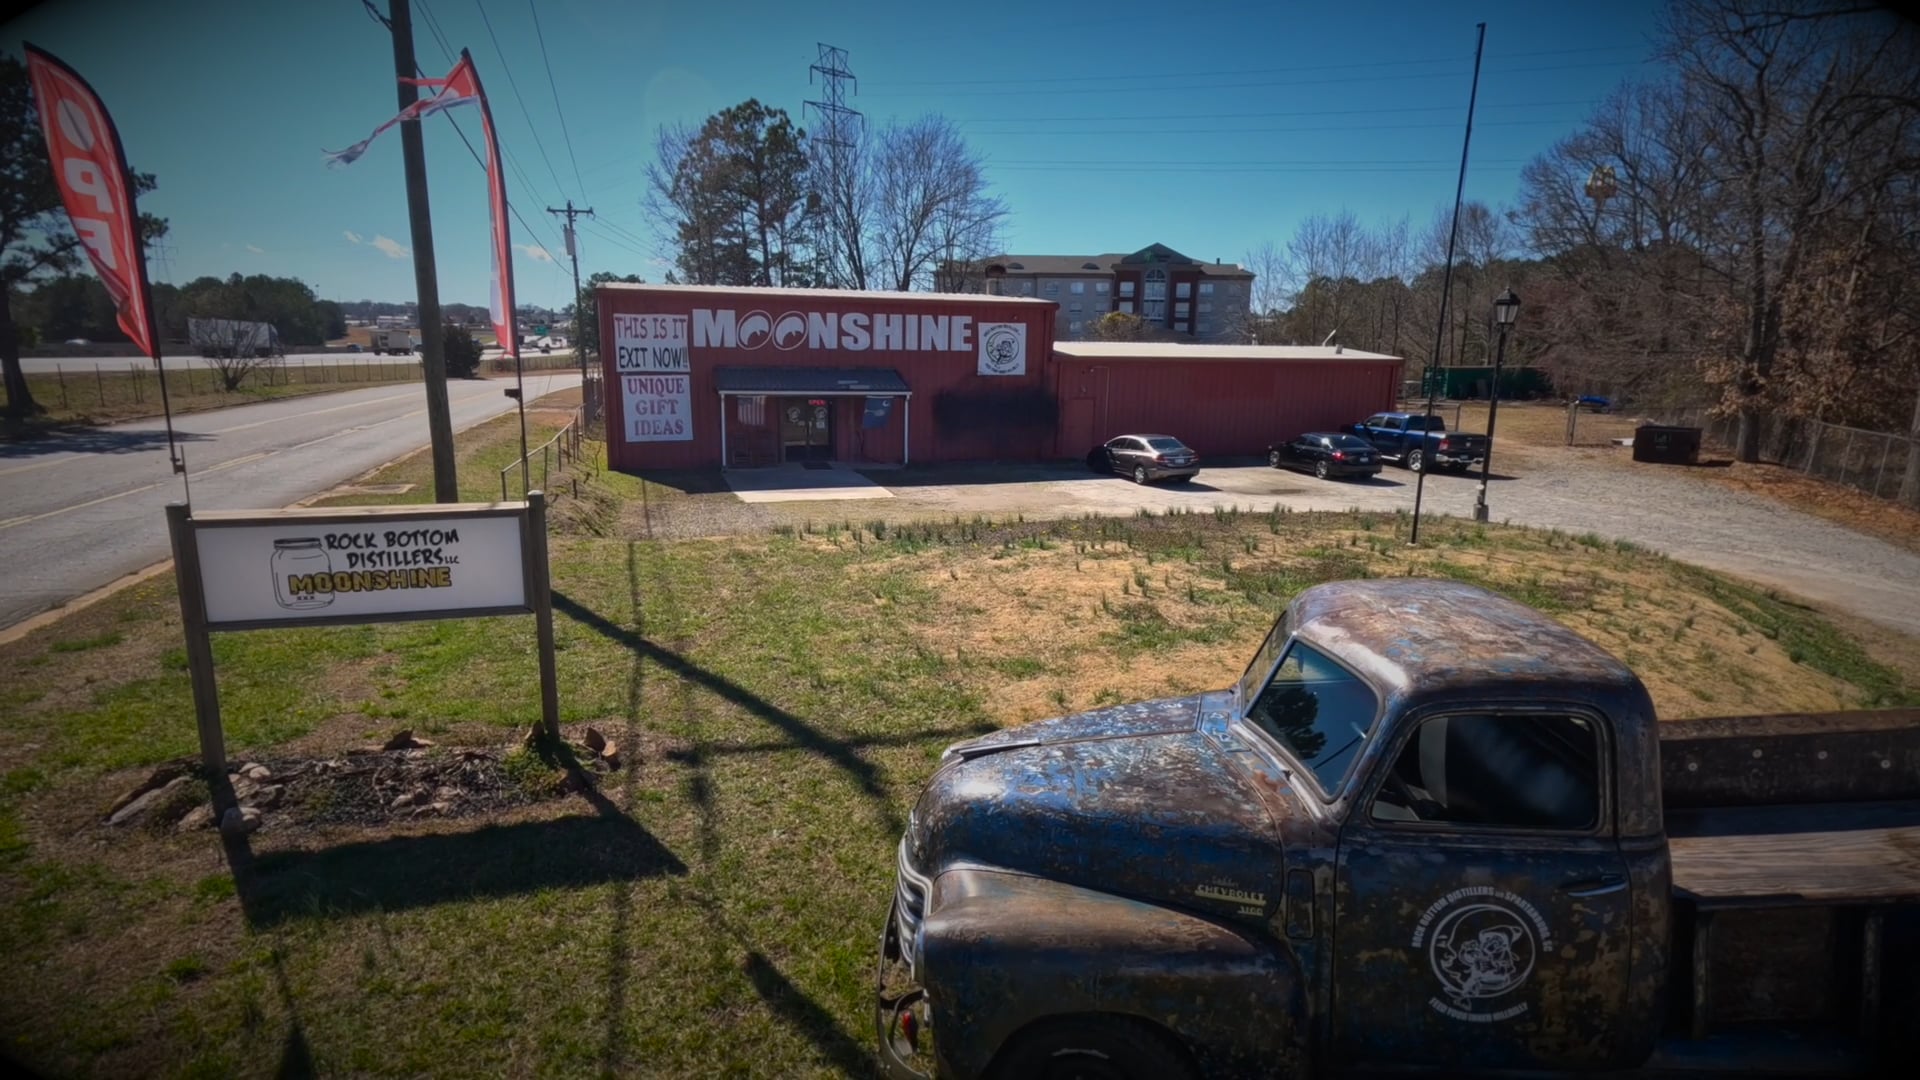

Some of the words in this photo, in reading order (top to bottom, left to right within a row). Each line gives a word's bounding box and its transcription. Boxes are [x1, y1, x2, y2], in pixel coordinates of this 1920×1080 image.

[615, 317, 648, 339] THIS
[653, 318, 668, 339] IS
[673, 318, 687, 339] IT
[692, 309, 972, 351] MOONSHINE
[619, 347, 648, 369] EXIT
[653, 347, 689, 369] NOW!!
[628, 378, 685, 396] UNIQUE
[636, 400, 679, 415] GIFT
[635, 420, 684, 436] IDEAS
[324, 533, 378, 550] ROCK
[384, 529, 459, 547] BOTTOM
[347, 549, 444, 568] DISTILLERS
[444, 556, 460, 564] LLC
[288, 567, 452, 595] MOONSHINE
[1197, 884, 1265, 901] CHEVROLET
[1411, 925, 1425, 948] ROCK
[1419, 897, 1448, 926] BOTTOM
[1446, 886, 1494, 902] DISTILLERS
